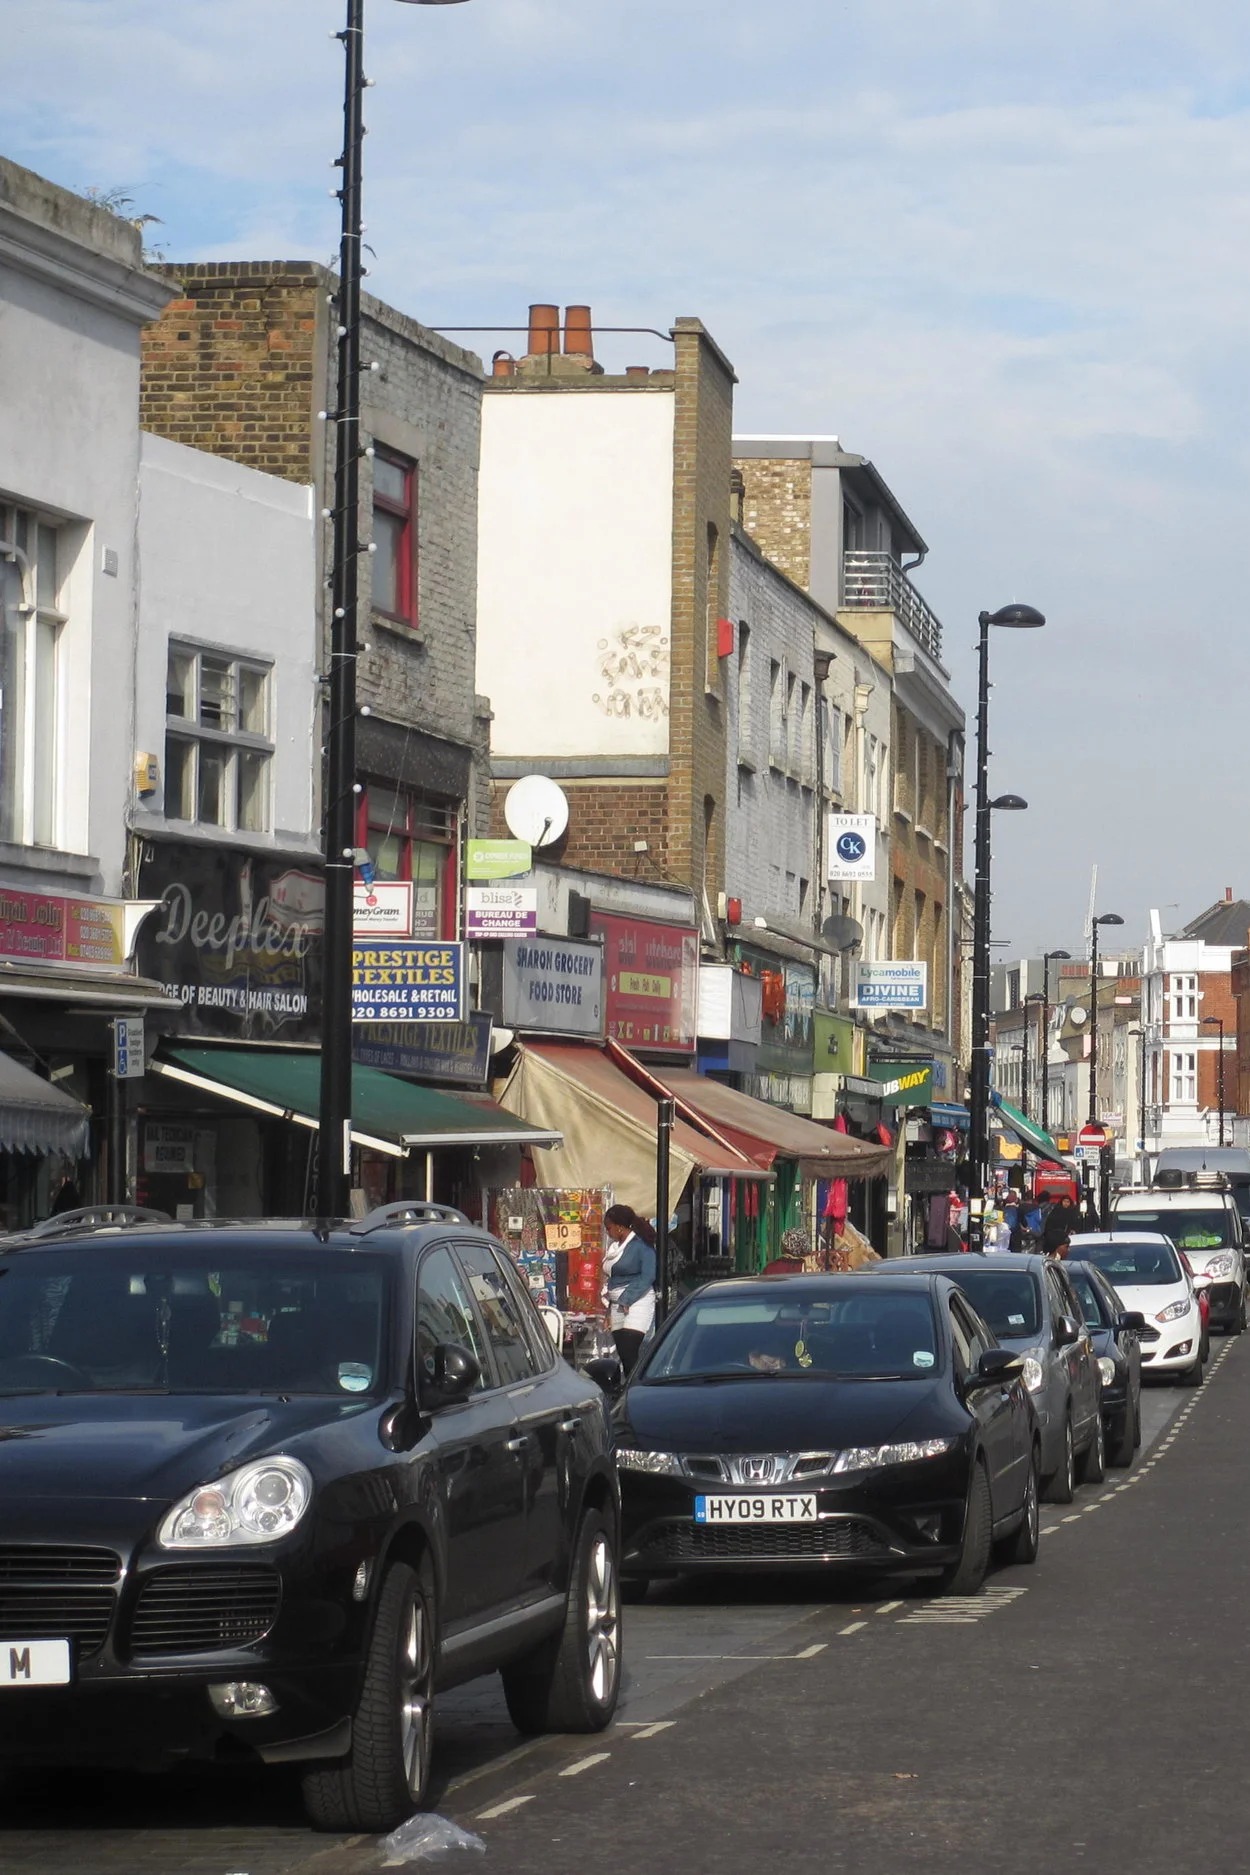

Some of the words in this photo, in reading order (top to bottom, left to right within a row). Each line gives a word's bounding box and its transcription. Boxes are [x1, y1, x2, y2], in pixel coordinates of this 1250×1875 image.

[836, 817, 848, 826] TO
[850, 818, 868, 826] LET
[353, 906, 400, 916] neyGram
[475, 911, 513, 919] BUREAU
[515, 911, 528, 919] DE
[155, 883, 312, 970] Deeplex
[481, 919, 521, 927] CHANGE
[353, 950, 453, 967] PRESTIGE
[517, 946, 553, 970] SHARON
[555, 952, 594, 976] GROCERY
[353, 968, 455, 985] TEXTILES
[860, 967, 920, 978] Lycamobile
[181, 985, 196, 1003] OF
[198, 986, 237, 1007] BEAUTY
[239, 990, 246, 1008] &
[249, 991, 273, 1011] HAIR
[273, 992, 307, 1013] SALON
[352, 989, 407, 1003] HOLESALE
[530, 980, 554, 1002] FOOD
[556, 984, 582, 1005] STORE
[863, 985, 919, 996] DIVINE
[380, 1007, 413, 1018] 8691
[418, 1007, 454, 1018] 9309
[360, 1023, 421, 1047] PRESTIGE
[425, 1024, 478, 1056] TEXTILES
[883, 1068, 930, 1097] UBWAY
[710, 1499, 765, 1519] HY09
[771, 1498, 813, 1518] RTX
[9, 1647, 31, 1679] M
